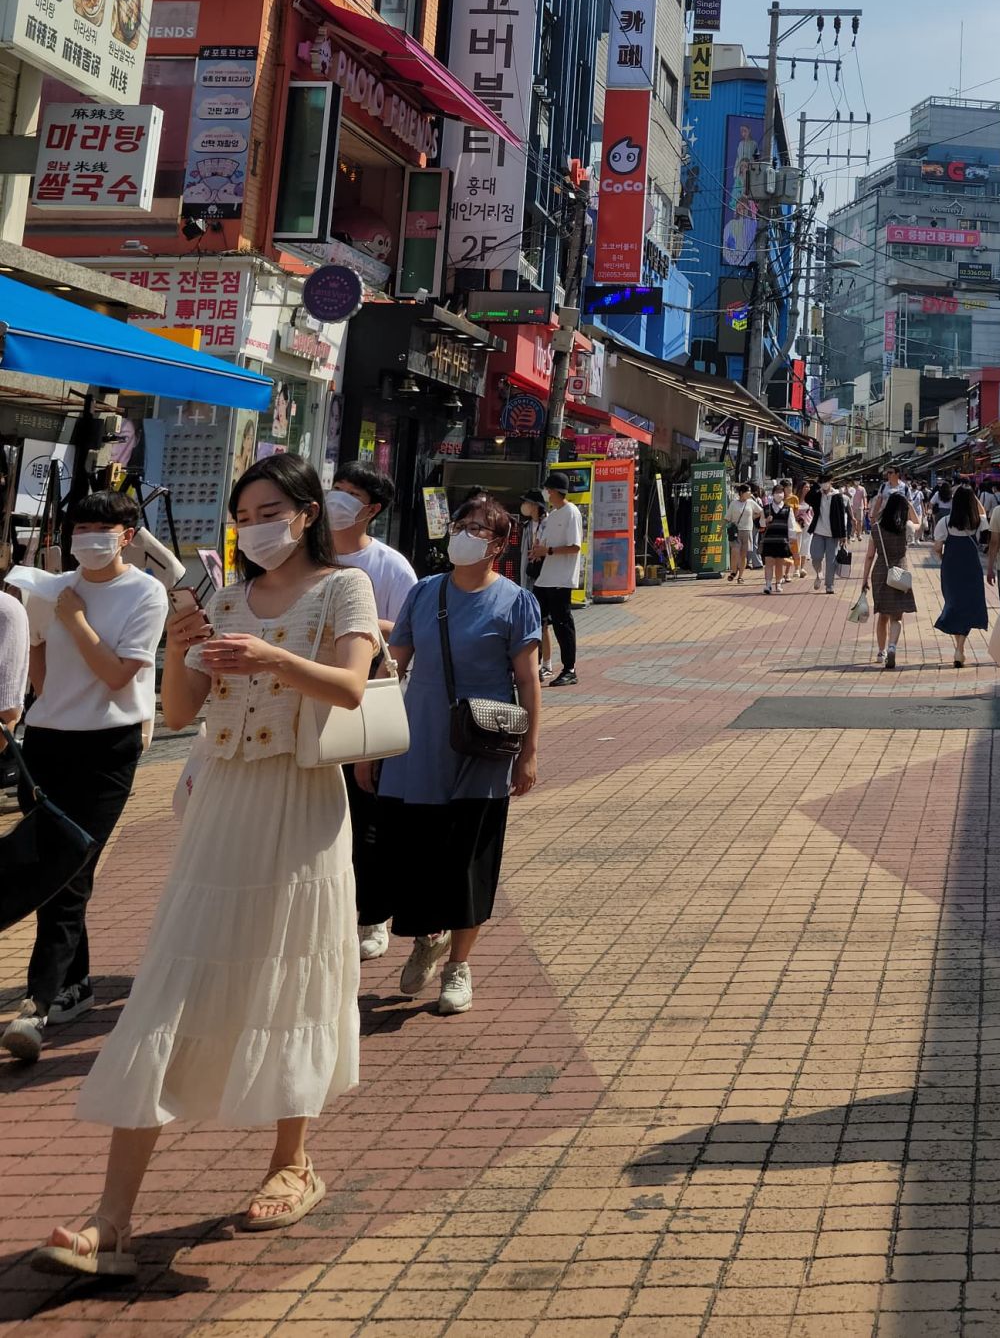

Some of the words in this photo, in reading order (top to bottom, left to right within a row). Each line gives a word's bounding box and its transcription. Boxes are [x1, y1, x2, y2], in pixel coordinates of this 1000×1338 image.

[696, 0, 720, 9] Single
[696, 8, 718, 16] Room
[693, 47, 712, 90] 사진
[71, 108, 126, 121] 麻辣烫
[336, 50, 385, 117] PHOTO
[382, 93, 439, 159] FRIENDS
[45, 123, 146, 153] 마라탕
[36, 173, 138, 202] 쌀국수
[466, 176, 497, 196] 홍대
[461, 235, 498, 262] 2F
[177, 270, 241, 294] 전문점
[175, 299, 238, 321] 專門店
[173, 404, 219, 427] 1+1
